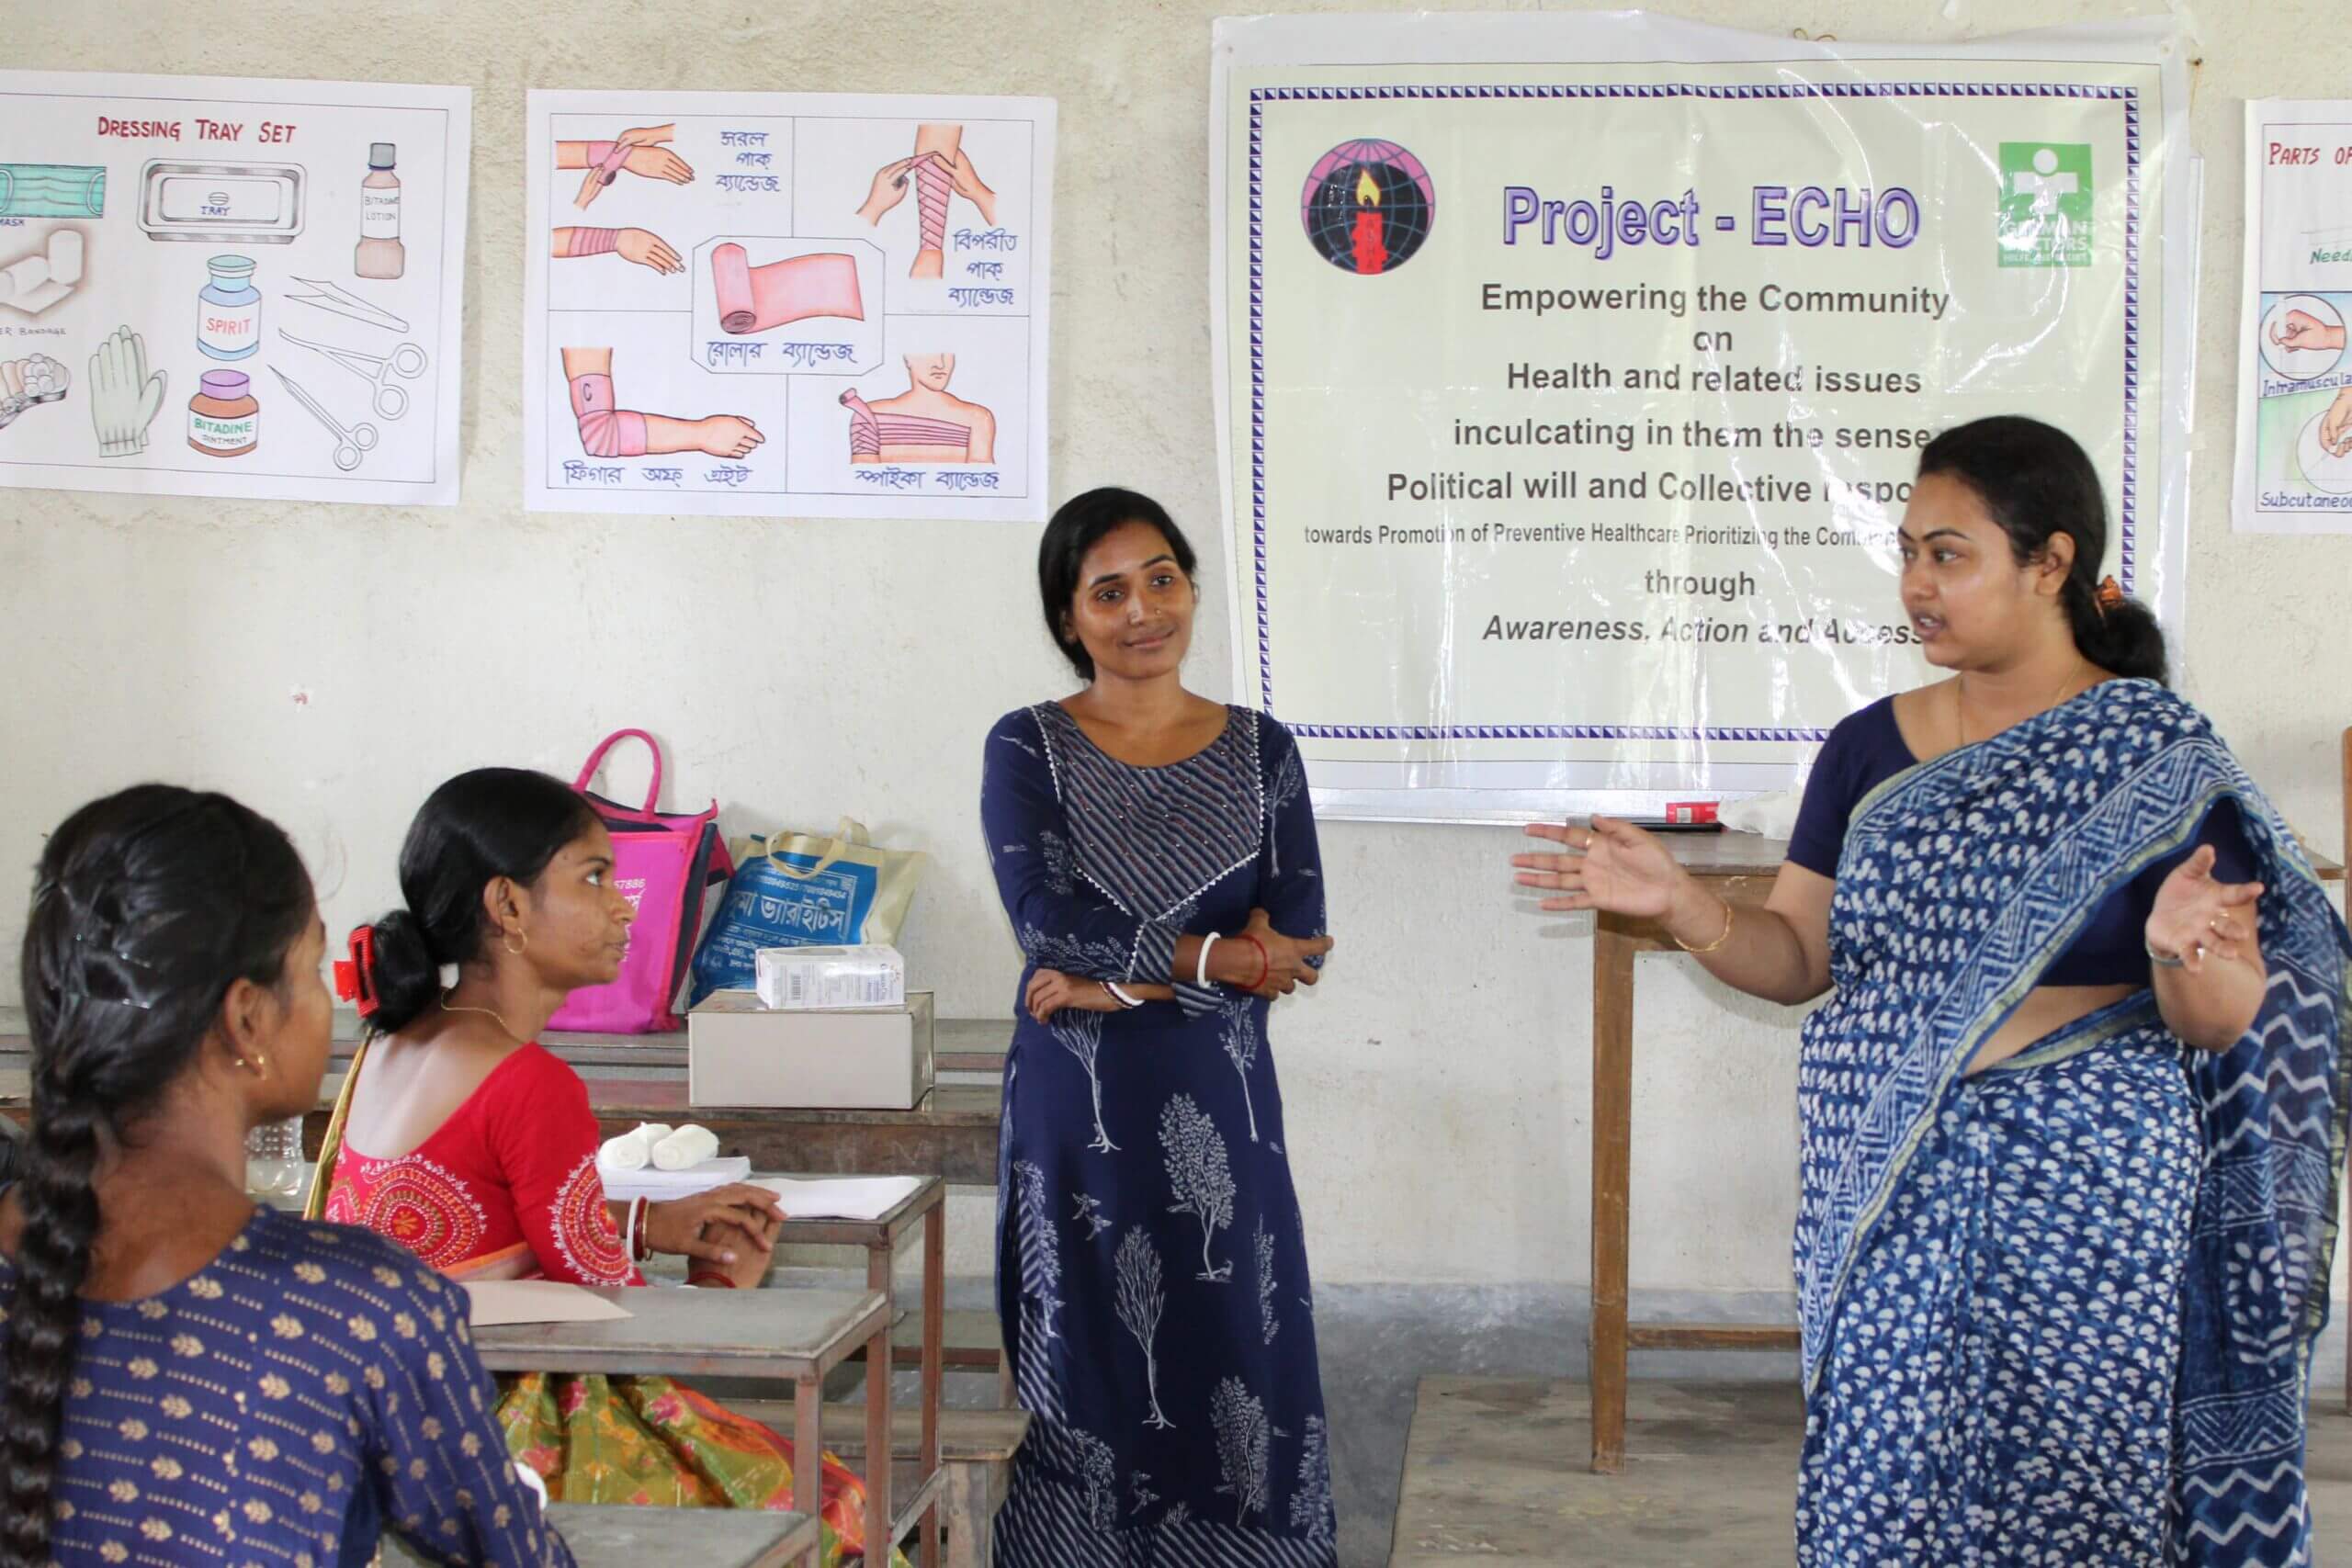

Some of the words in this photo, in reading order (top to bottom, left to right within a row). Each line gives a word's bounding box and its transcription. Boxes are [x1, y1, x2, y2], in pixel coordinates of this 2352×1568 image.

[97, 116, 182, 141] DRESSING
[195, 118, 243, 141] TRAY
[257, 121, 297, 143] SET
[2268, 142, 2321, 165] PARTS
[199, 205, 231, 217] TRAY
[1502, 186, 1700, 260] Project
[1751, 186, 1920, 248] ECHO
[1481, 283, 1687, 318] Empowering
[1697, 285, 1747, 311] the
[1758, 284, 1950, 320] Community
[205, 318, 251, 335] SPIRIT
[1693, 330, 1734, 352] on
[1508, 362, 1612, 389] Health
[1623, 365, 1680, 391] and
[1691, 366, 1803, 392] related
[1815, 366, 1922, 393] issues
[194, 418, 253, 434] BITADINE
[1454, 419, 1634, 450] inculcating
[1647, 419, 1673, 446] in
[1683, 420, 1763, 448] them
[1773, 421, 1824, 449] the
[1835, 426, 1931, 450] sense
[1387, 472, 1512, 501] Political
[1523, 471, 1577, 499] will
[1588, 472, 1647, 499] and
[1658, 472, 1812, 502] Collective
[2261, 492, 2352, 507] Subcutaneo
[1305, 525, 1373, 544] towards
[1471, 523, 1488, 542] of
[1494, 523, 1586, 542] Preventive
[1591, 523, 1679, 544] Healthcare
[1684, 525, 1779, 549] Prioritizing
[1784, 525, 1810, 546] the
[1645, 570, 1755, 601] through
[1660, 615, 1748, 643] Action
[1758, 619, 1814, 644] and
